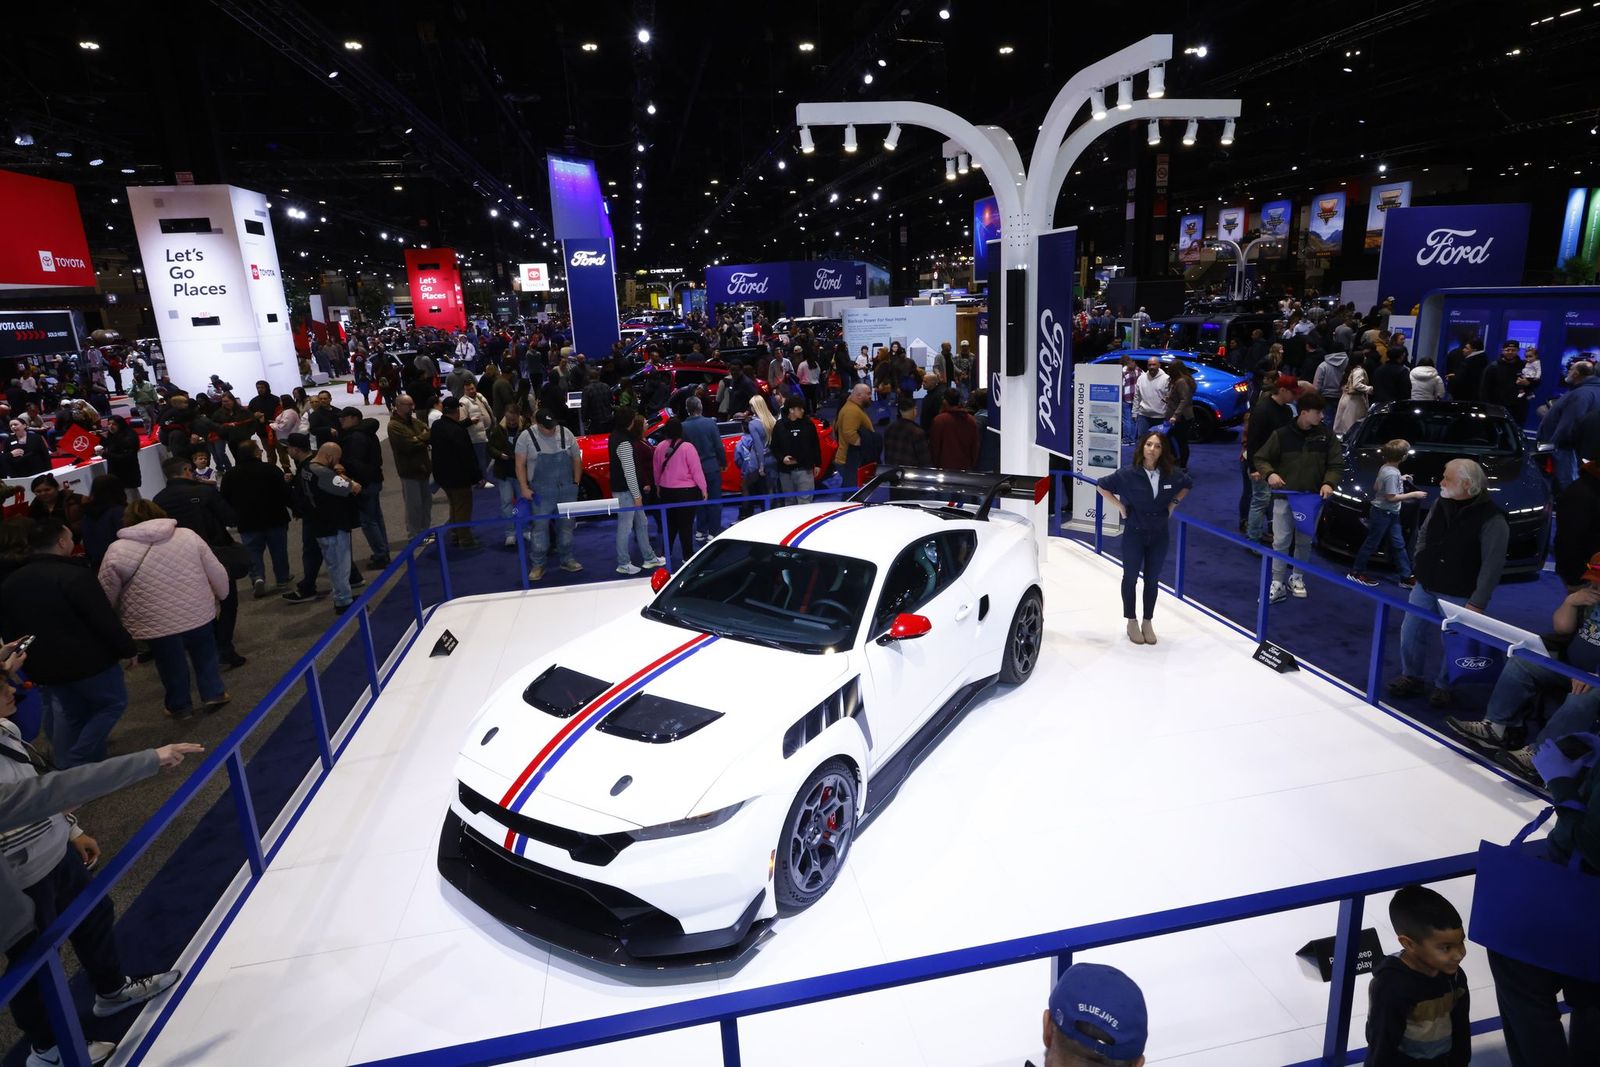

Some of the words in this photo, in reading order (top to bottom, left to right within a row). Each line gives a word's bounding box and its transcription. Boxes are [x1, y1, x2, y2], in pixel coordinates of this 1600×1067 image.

[1417, 228, 1494, 266] Ford
[166, 248, 204, 262] Let's
[571, 250, 606, 267] Ford
[55, 257, 86, 269] TOYOTA
[169, 266, 195, 279] Go
[813, 268, 842, 290] Ford
[173, 283, 227, 297] Places
[420, 284, 433, 292] Go
[727, 272, 769, 295] Ford
[16, 321, 34, 330] GEAR
[1040, 308, 1064, 436] Ford
[1077, 382, 1085, 405] FORD
[1076, 449, 1084, 466] GTD
[1085, 507, 1107, 520] Fod
[1260, 650, 1273, 659] Please
[1268, 646, 1280, 656] Ford
[1462, 658, 1487, 668] Ford
[1356, 960, 1373, 971] play
